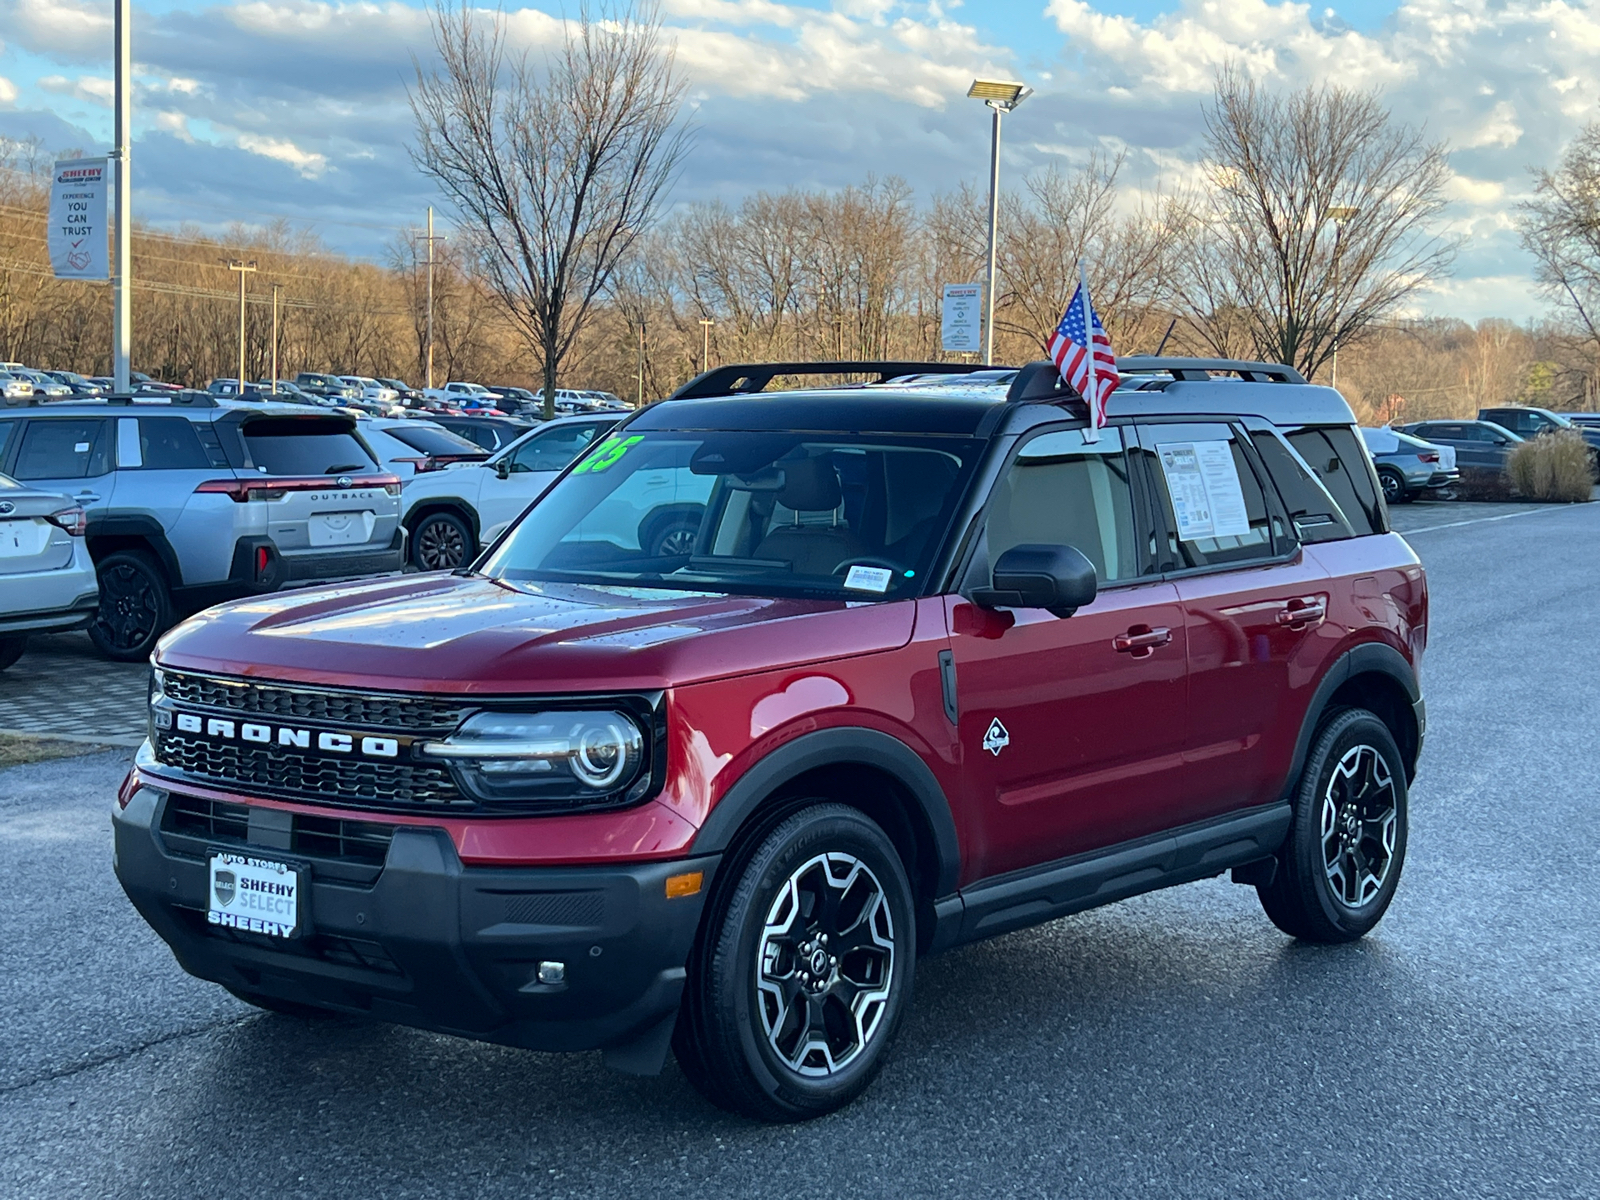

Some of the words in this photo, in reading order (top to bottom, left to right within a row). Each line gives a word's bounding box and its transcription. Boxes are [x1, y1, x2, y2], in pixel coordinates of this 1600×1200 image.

[62, 168, 102, 178] SHEEHY
[68, 202, 88, 211] YOU
[67, 214, 87, 223] CAN
[62, 226, 92, 236] TRUST
[572, 435, 645, 475] 25
[310, 492, 374, 501] OUTBACK
[176, 713, 398, 757] BRONCO
[216, 852, 245, 865] AUTO
[248, 858, 288, 872] STORES
[240, 877, 294, 898] SHEEHY
[240, 892, 294, 916] SELECT
[208, 910, 294, 938] SHEEHY
